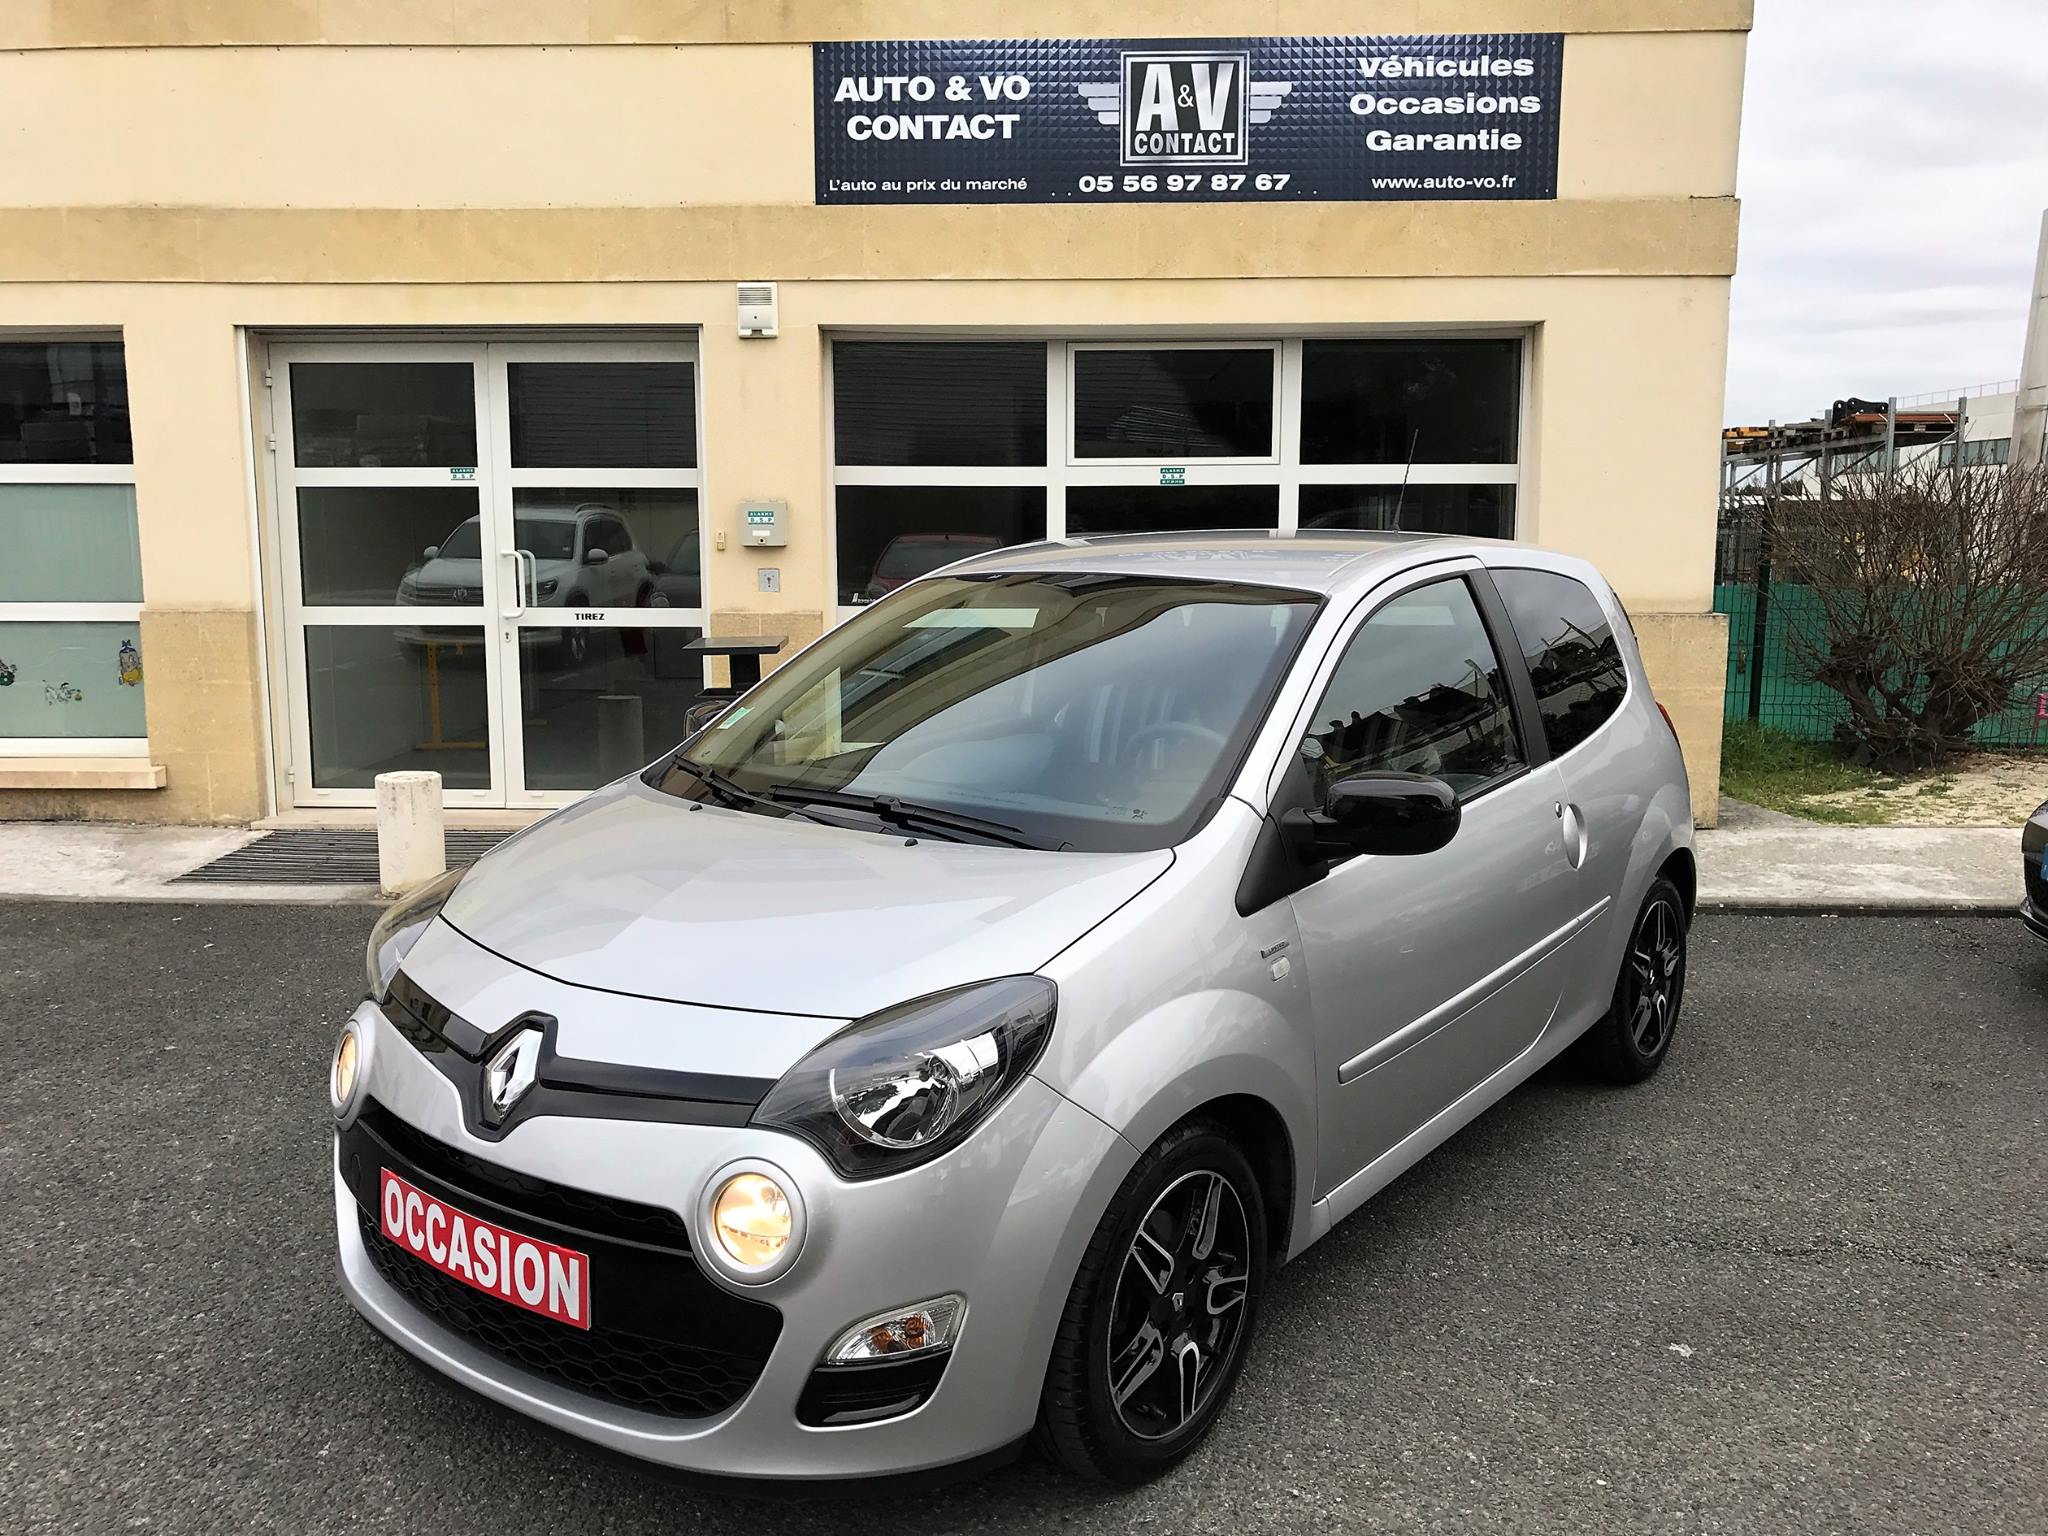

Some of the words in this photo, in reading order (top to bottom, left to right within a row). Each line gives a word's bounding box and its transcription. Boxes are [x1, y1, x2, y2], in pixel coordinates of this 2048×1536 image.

[1357, 54, 1535, 78] Véhicules
[833, 76, 936, 102] AUTO
[944, 75, 973, 102] &
[978, 72, 1035, 101] VO
[1349, 92, 1541, 116] Occasions
[846, 114, 1021, 141] CONTACT
[1134, 132, 1236, 155] CONTACT
[1365, 128, 1522, 152] Garantie
[829, 179, 877, 191] L'auto
[881, 181, 901, 191] au
[906, 178, 936, 195] prix
[940, 178, 961, 191] du
[966, 177, 1028, 191] marché
[1078, 175, 1114, 193] 05
[1122, 174, 1158, 192] 56
[1166, 174, 1202, 192] 97
[1210, 173, 1247, 191] 87
[1255, 173, 1291, 191] 67
[1371, 174, 1517, 189] www.auto-vo.fr
[574, 613, 605, 621] TIREZ
[384, 1178, 580, 1321] OCCASION
